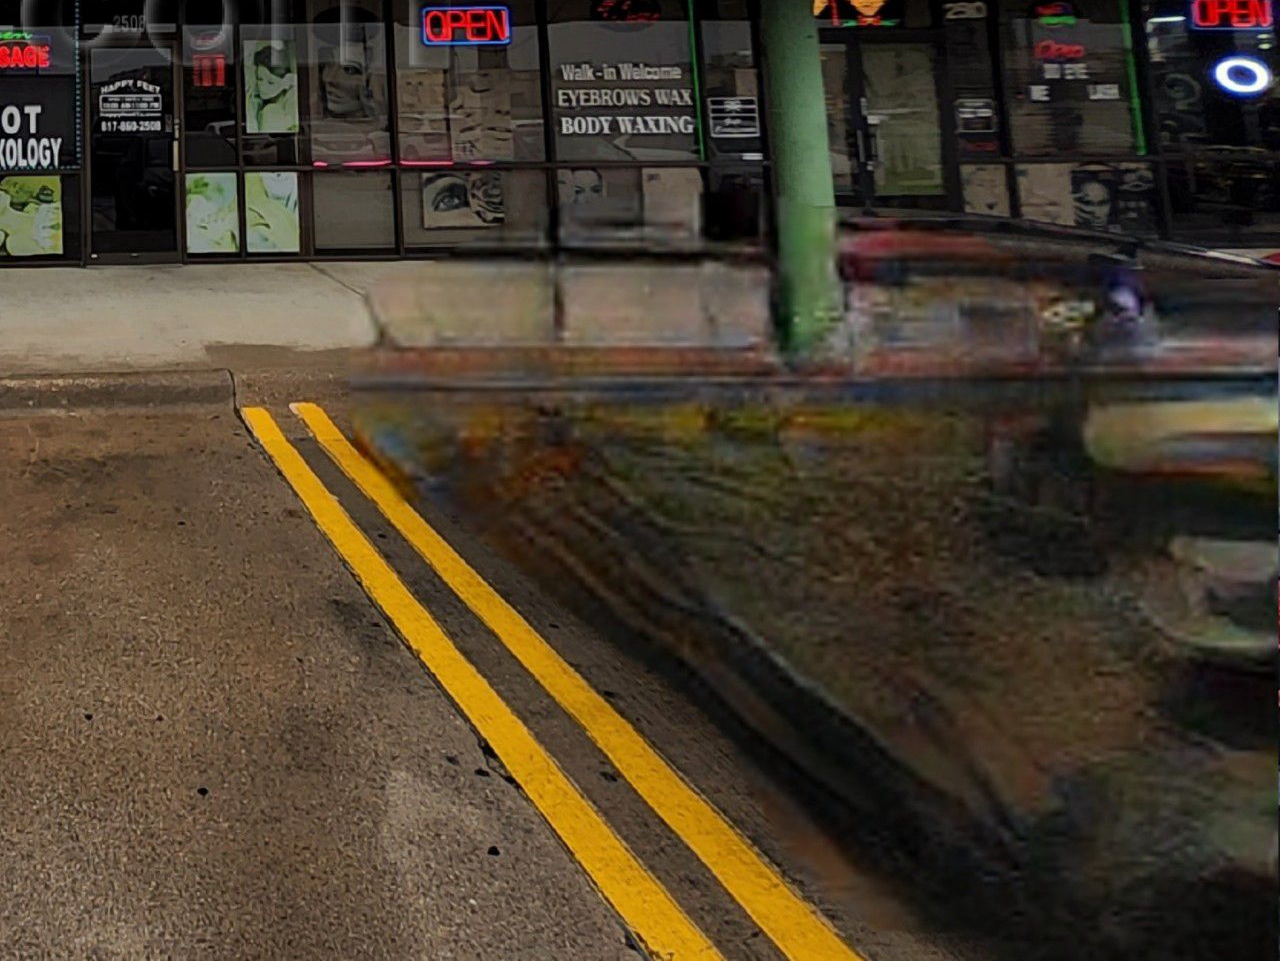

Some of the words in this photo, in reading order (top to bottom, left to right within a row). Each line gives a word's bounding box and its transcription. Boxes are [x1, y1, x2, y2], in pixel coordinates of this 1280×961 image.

[424, 10, 507, 41] OPEN
[618, 63, 682, 80] Welcome
[557, 88, 651, 107] EYEBROWS
[655, 89, 694, 106] WAX
[561, 116, 614, 135] BODY
[616, 116, 695, 134] WAXING
